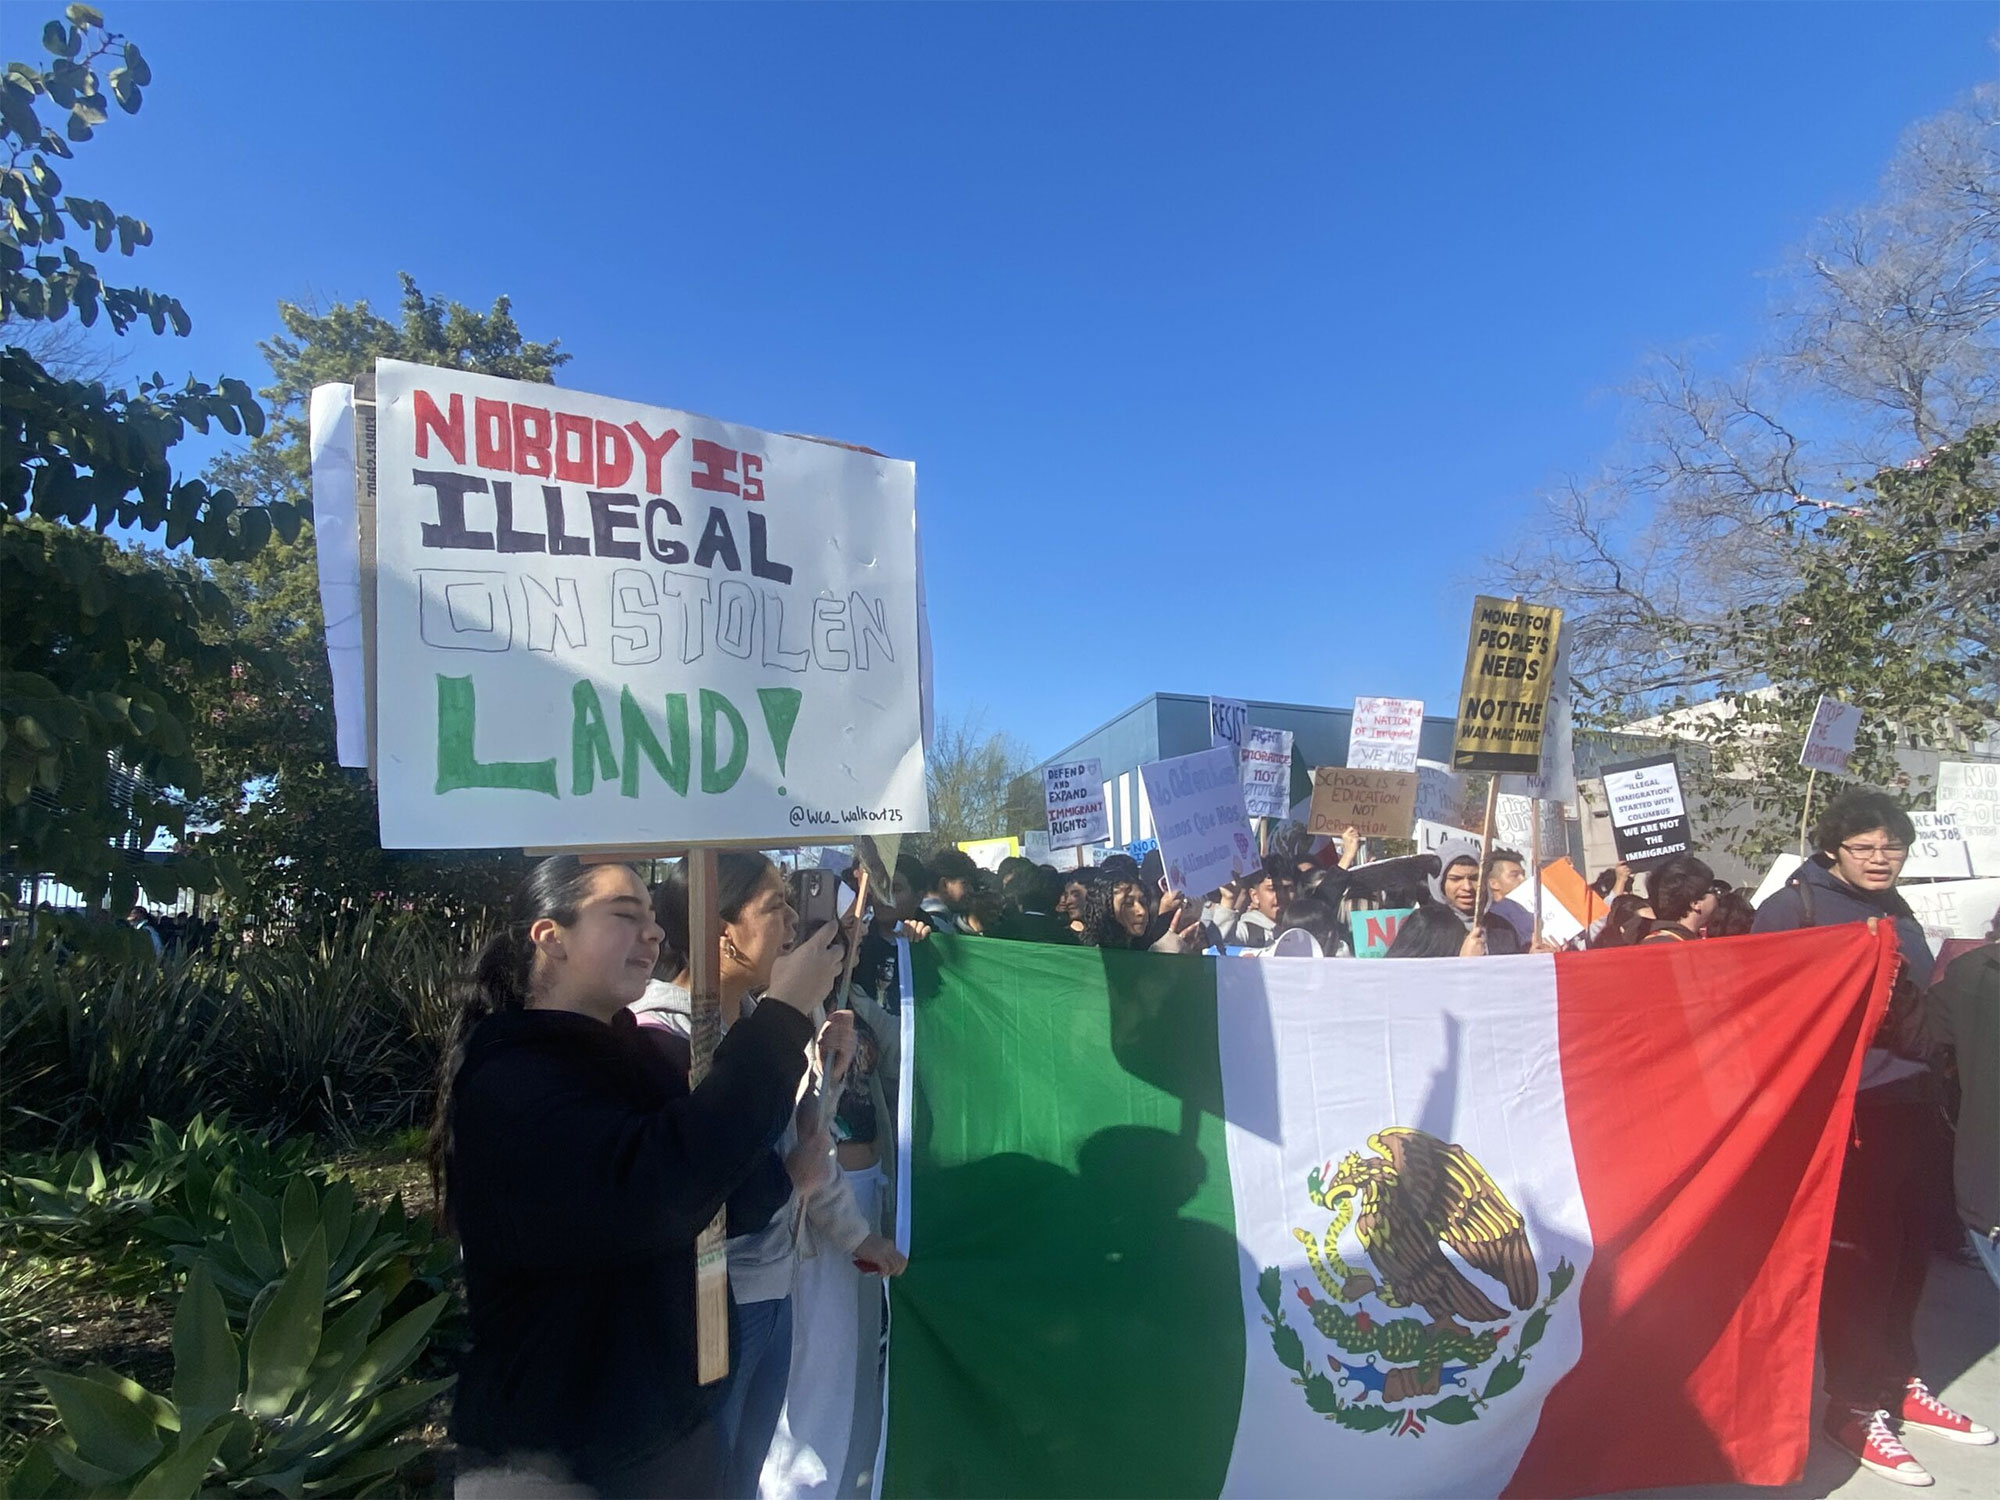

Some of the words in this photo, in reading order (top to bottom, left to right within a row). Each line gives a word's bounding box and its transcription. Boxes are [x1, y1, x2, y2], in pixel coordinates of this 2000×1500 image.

[414, 390, 680, 495] NOBODY
[691, 438, 764, 501] IS
[413, 469, 793, 584] ILLEGAL
[414, 567, 587, 653] ON
[610, 567, 895, 672] STOLEN
[1480, 608, 1527, 629] MONEY
[1526, 614, 1551, 632] FOR
[1477, 628, 1550, 655] PEOPLE'S
[1480, 654, 1540, 681] NEEDS
[1464, 697, 1508, 721] NOT
[1509, 701, 1544, 725] THE
[1211, 702, 1246, 746] RESIST
[1374, 715, 1412, 727] NATION
[435, 672, 802, 800] LAND!
[1462, 725, 1489, 740] WAR
[1490, 727, 1541, 743] MACHINE
[1361, 748, 1384, 762] WE
[1387, 750, 1416, 767] MUST
[1048, 765, 1085, 780] DEFEND
[1964, 765, 1998, 788] NO
[1053, 781, 1070, 790] AND
[1049, 788, 1087, 803] EXPAND
[1331, 787, 1401, 805] EDUCATION
[1619, 801, 1653, 813] STARTED
[1653, 796, 1674, 806] WITH
[1048, 802, 1103, 821] IMMIGRANT
[1352, 803, 1378, 817] NOT
[1627, 807, 1671, 822] COLUMBUS
[1052, 818, 1087, 836] RIGHTS
[1622, 826, 1639, 837] WE
[1640, 823, 1659, 834] ARE
[1659, 819, 1680, 831] NOT
[1913, 814, 1931, 828] RE
[1933, 813, 1957, 827] NOT
[1645, 834, 1664, 846] THE
[1939, 827, 1961, 841] JOB
[1625, 842, 1687, 862] IMMIGRANTS
